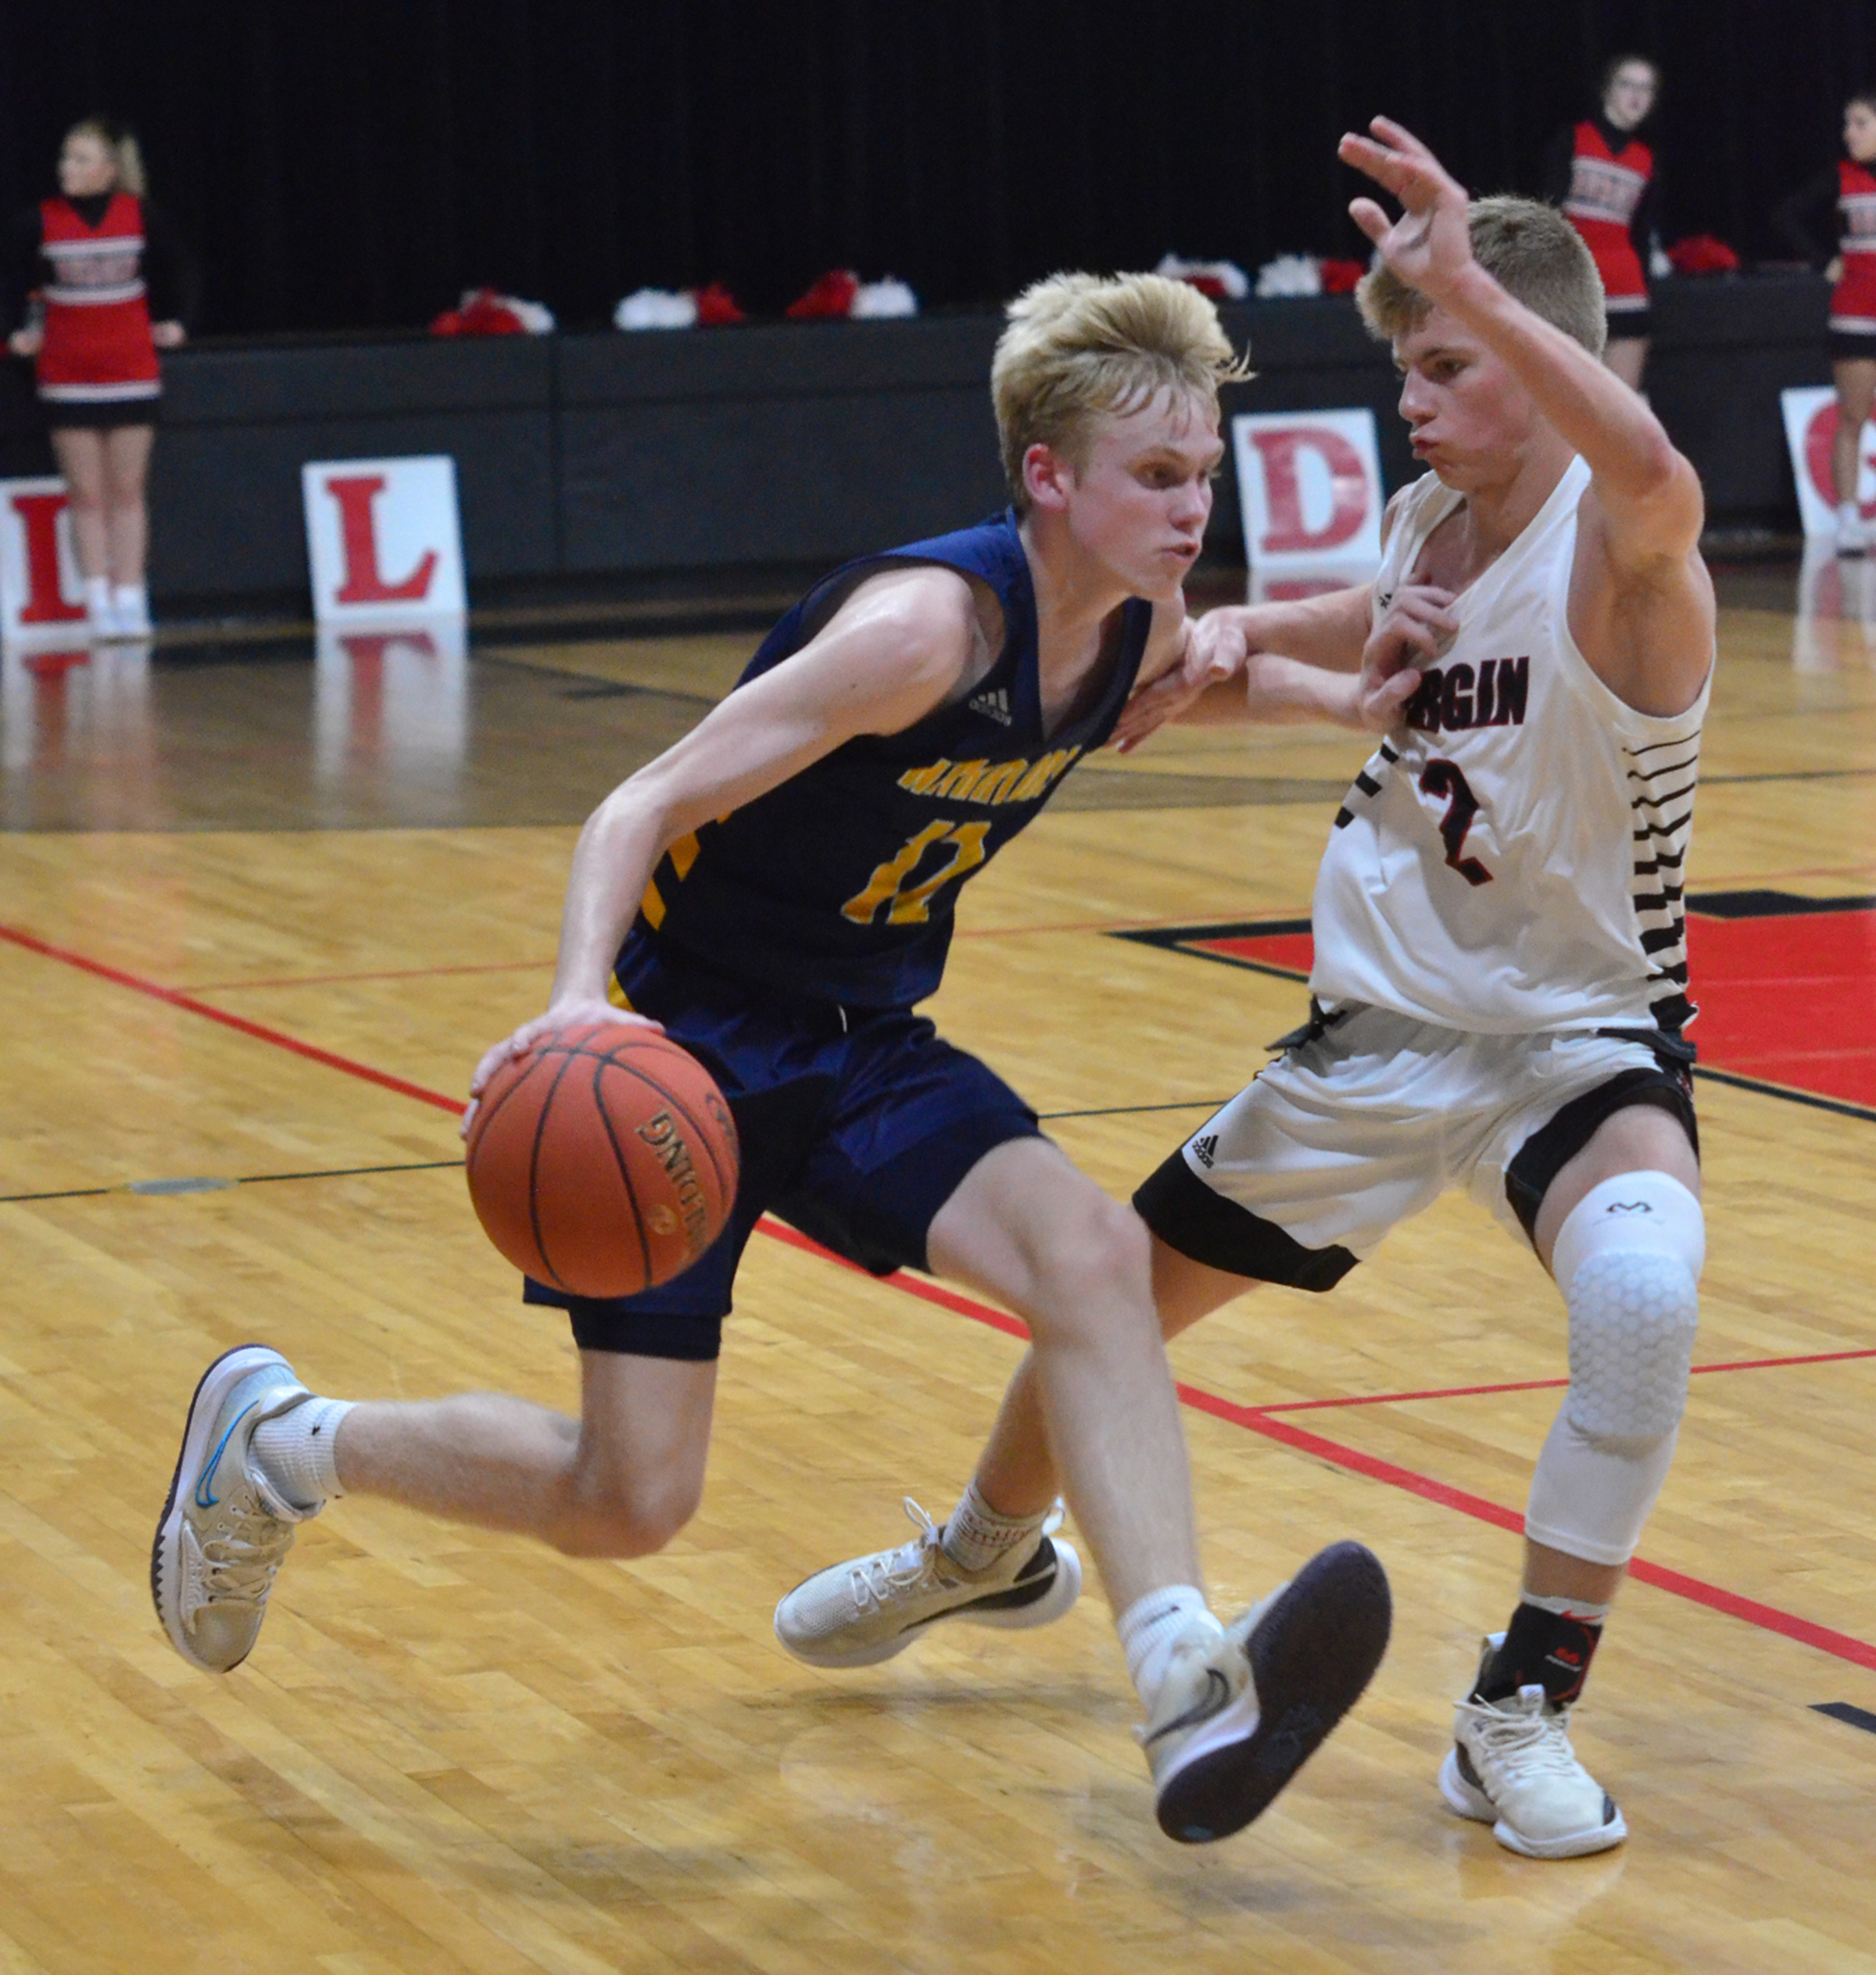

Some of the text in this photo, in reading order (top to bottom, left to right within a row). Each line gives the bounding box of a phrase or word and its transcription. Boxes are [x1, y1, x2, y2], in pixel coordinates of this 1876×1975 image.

[325, 476, 439, 605] L
[1251, 430, 1367, 553] D
[1402, 655, 1530, 733] RGIN
[1419, 757, 1494, 886] 2
